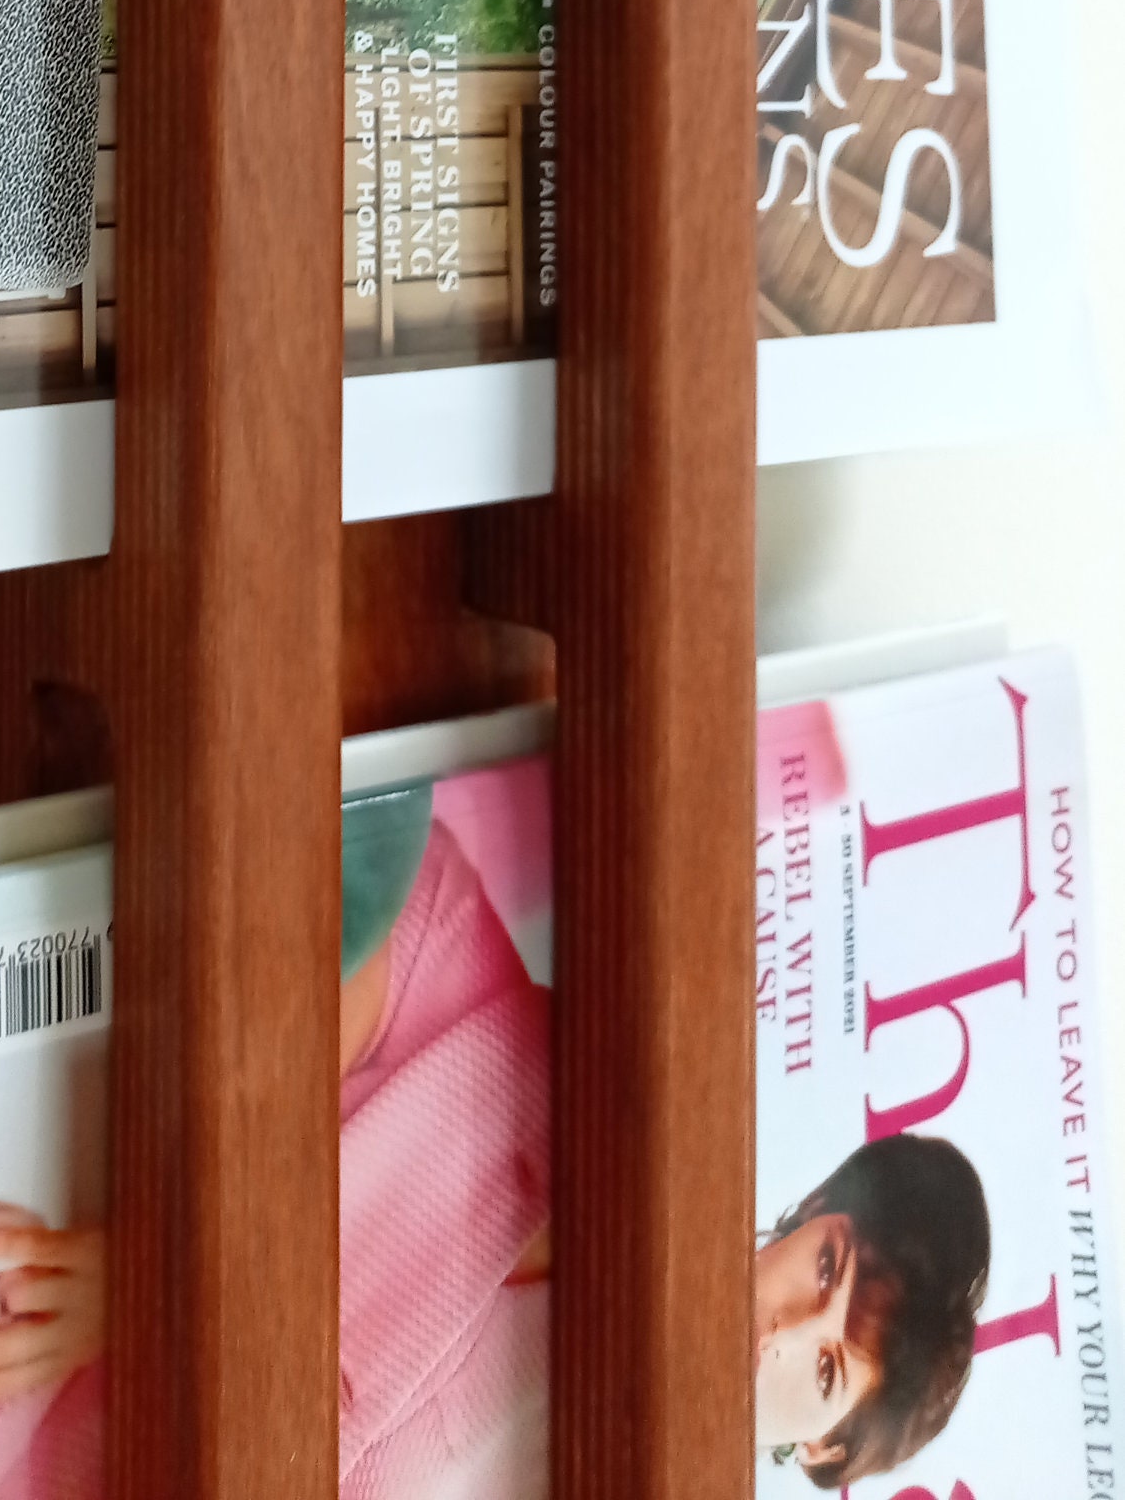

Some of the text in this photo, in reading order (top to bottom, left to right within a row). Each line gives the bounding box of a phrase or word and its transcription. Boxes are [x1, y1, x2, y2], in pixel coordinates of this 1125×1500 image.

[353, 30, 376, 298] & HAPPY HOMES
[408, 48, 433, 276] OF SPRING
[434, 32, 460, 293] FIRST SIGNS
[538, 24, 557, 148] COLOUR
[383, 160, 402, 280] BRIGHT
[539, 160, 557, 308] PAIRINGS
[17, 926, 93, 965] 770023
[756, 827, 777, 1025] A CAUSE
[780, 750, 813, 1075] REBEL WITH
[841, 863, 855, 985] SEPTEMBER
[1050, 786, 1115, 1500] HOW TO LEAVE IT WHY YOUR LE
